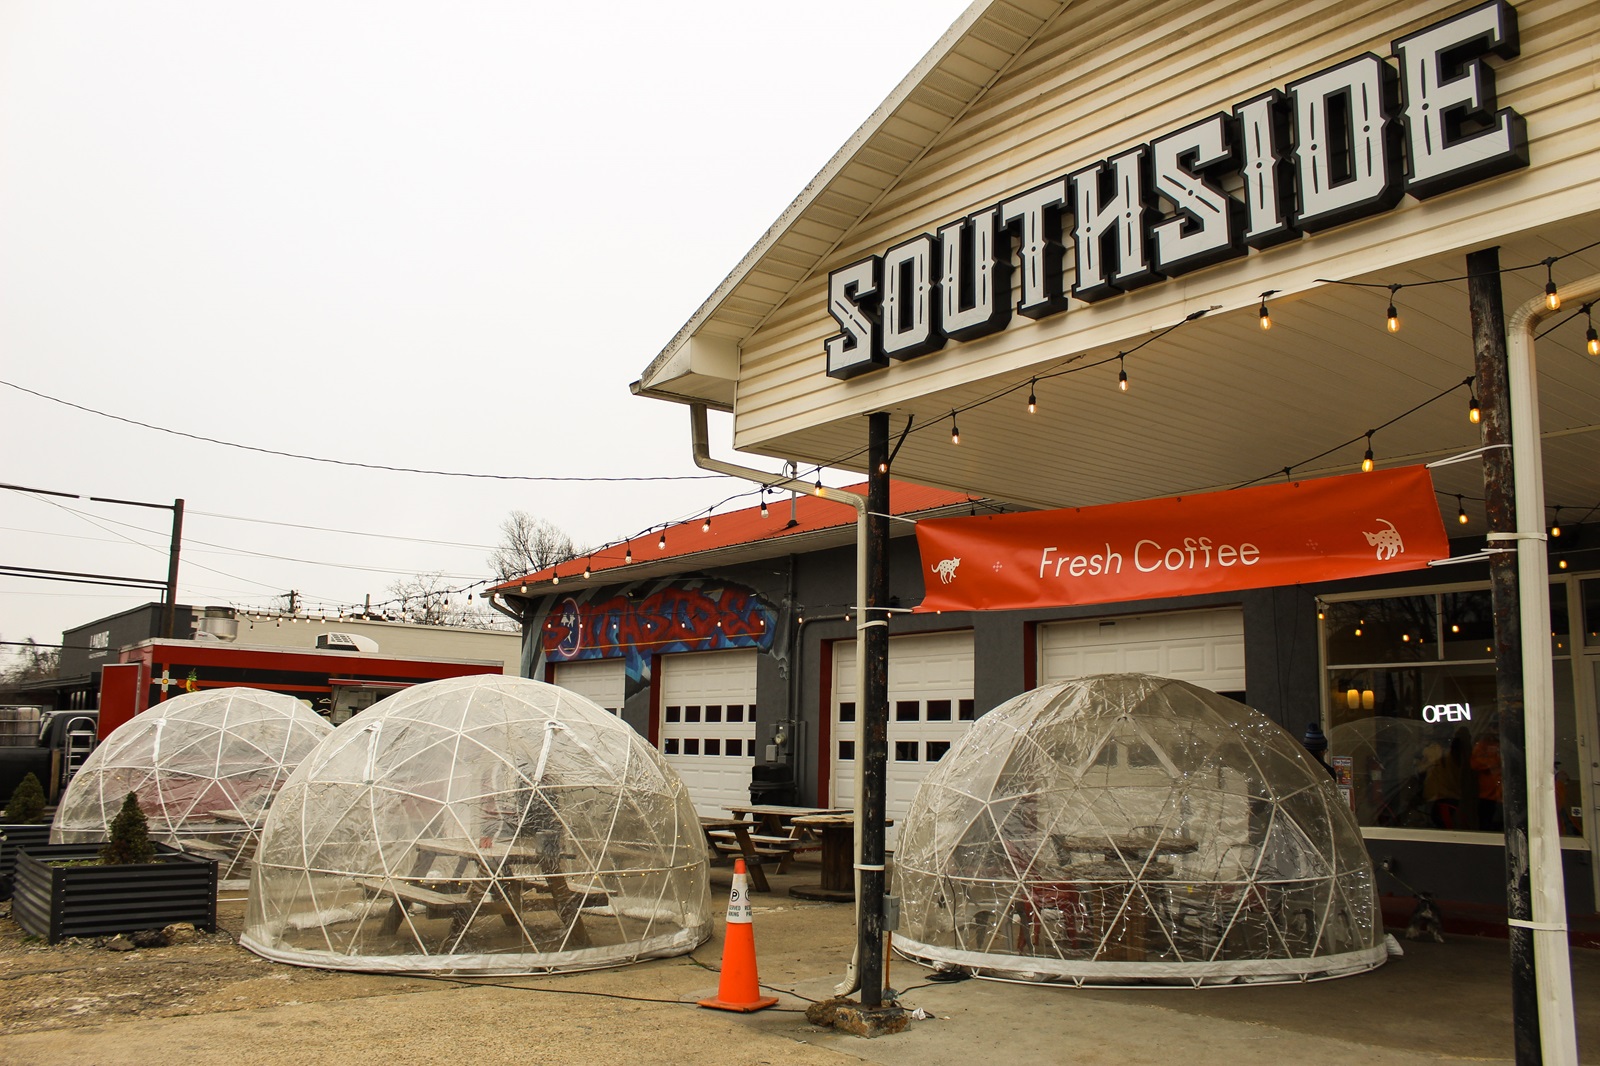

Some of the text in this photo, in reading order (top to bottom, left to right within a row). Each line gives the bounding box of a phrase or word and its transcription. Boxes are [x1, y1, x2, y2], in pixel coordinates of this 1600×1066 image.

[825, 0, 1529, 379] SOUTHSIDE
[1039, 536, 1260, 578] Fresh Coffee
[1422, 702, 1471, 723] OPEN
